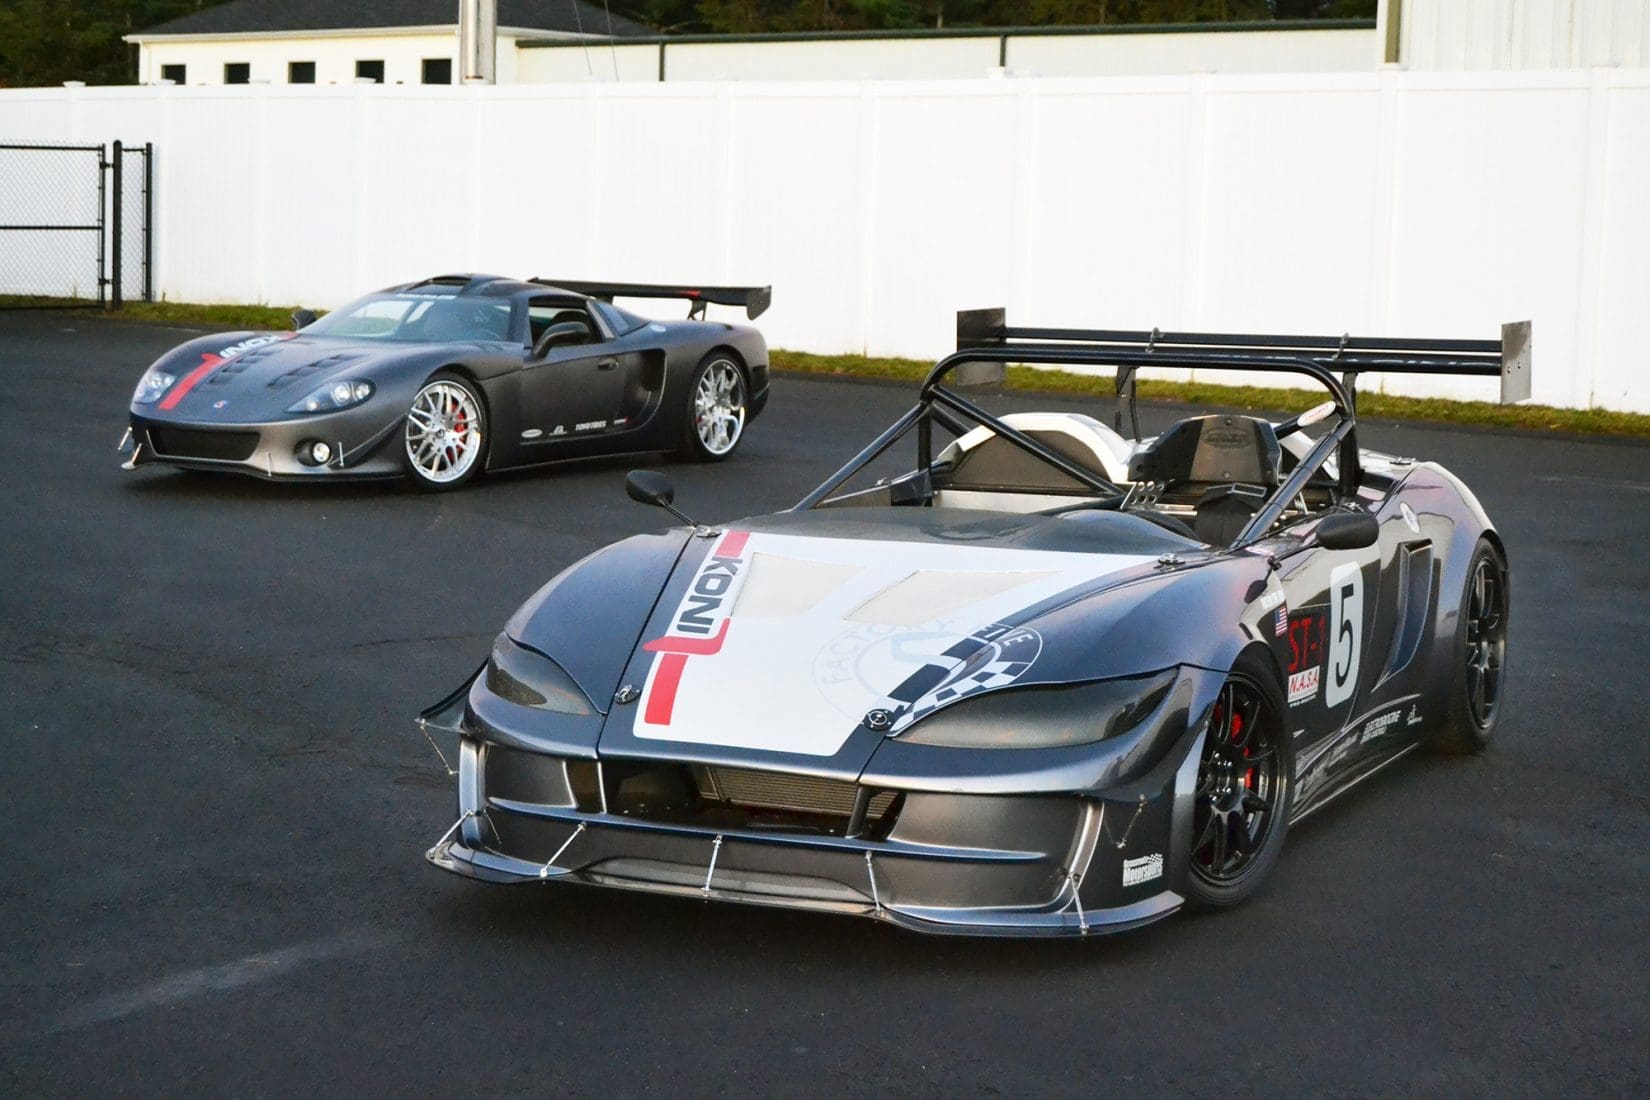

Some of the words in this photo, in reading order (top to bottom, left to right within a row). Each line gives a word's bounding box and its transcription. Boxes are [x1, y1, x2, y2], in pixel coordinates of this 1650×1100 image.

[219, 335, 282, 359] KONI
[677, 556, 743, 634] KONI
[821, 617, 953, 685] FACTOY
[1335, 583, 1355, 688] 5
